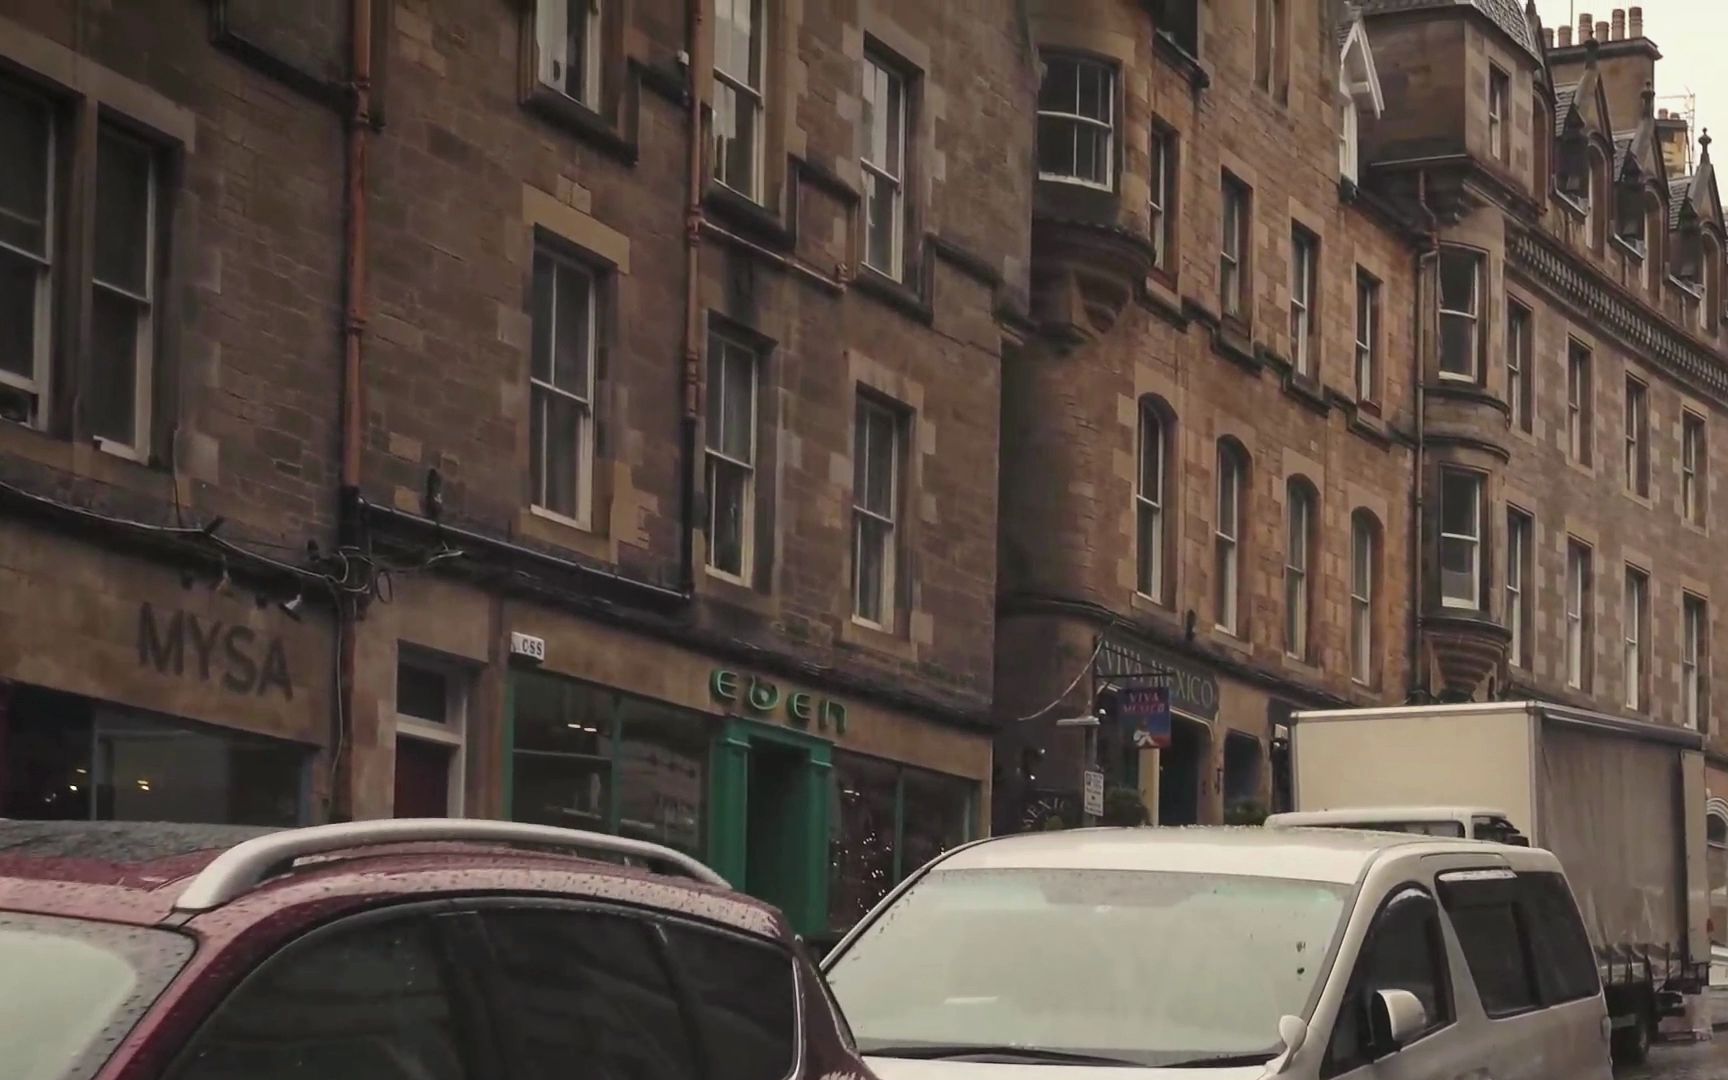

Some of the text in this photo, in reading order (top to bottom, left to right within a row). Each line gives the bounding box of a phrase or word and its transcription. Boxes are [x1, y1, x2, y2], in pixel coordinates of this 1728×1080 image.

[138, 602, 293, 700] MYSA
[1104, 640, 1213, 707] VIVA MEXICO
[1129, 692, 1159, 703] VIVA
